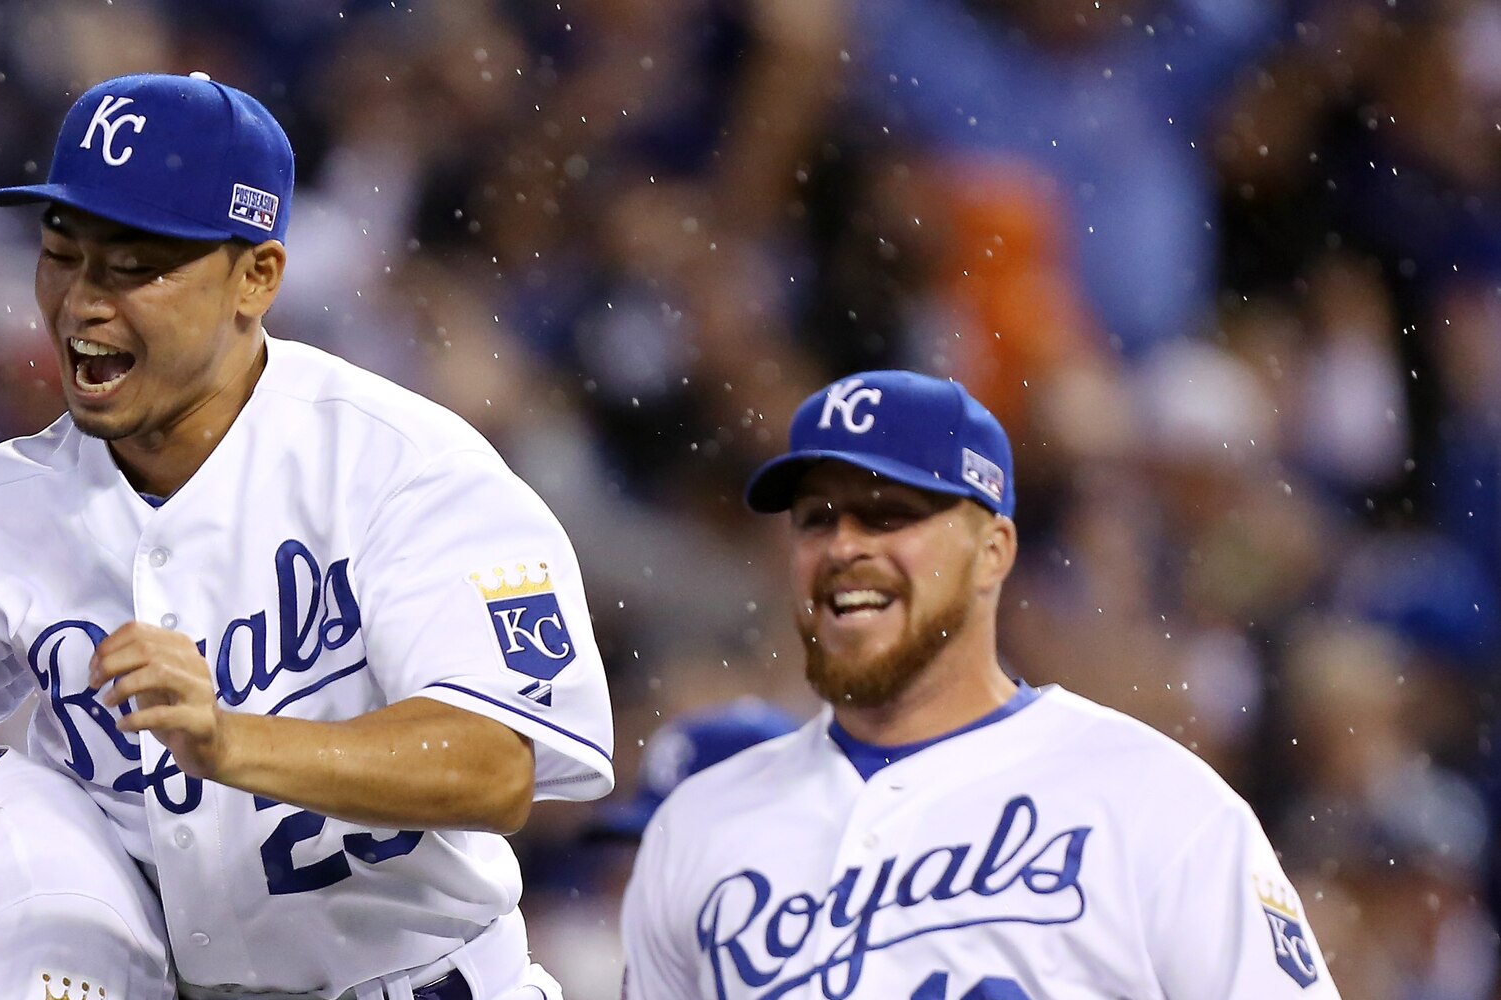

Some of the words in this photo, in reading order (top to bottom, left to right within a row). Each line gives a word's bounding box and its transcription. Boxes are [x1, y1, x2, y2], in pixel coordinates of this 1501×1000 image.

[79, 94, 147, 167] KC
[816, 378, 883, 435] KC
[493, 606, 571, 660] KC
[27, 538, 367, 815] Rals
[1265, 912, 1318, 980] KC
